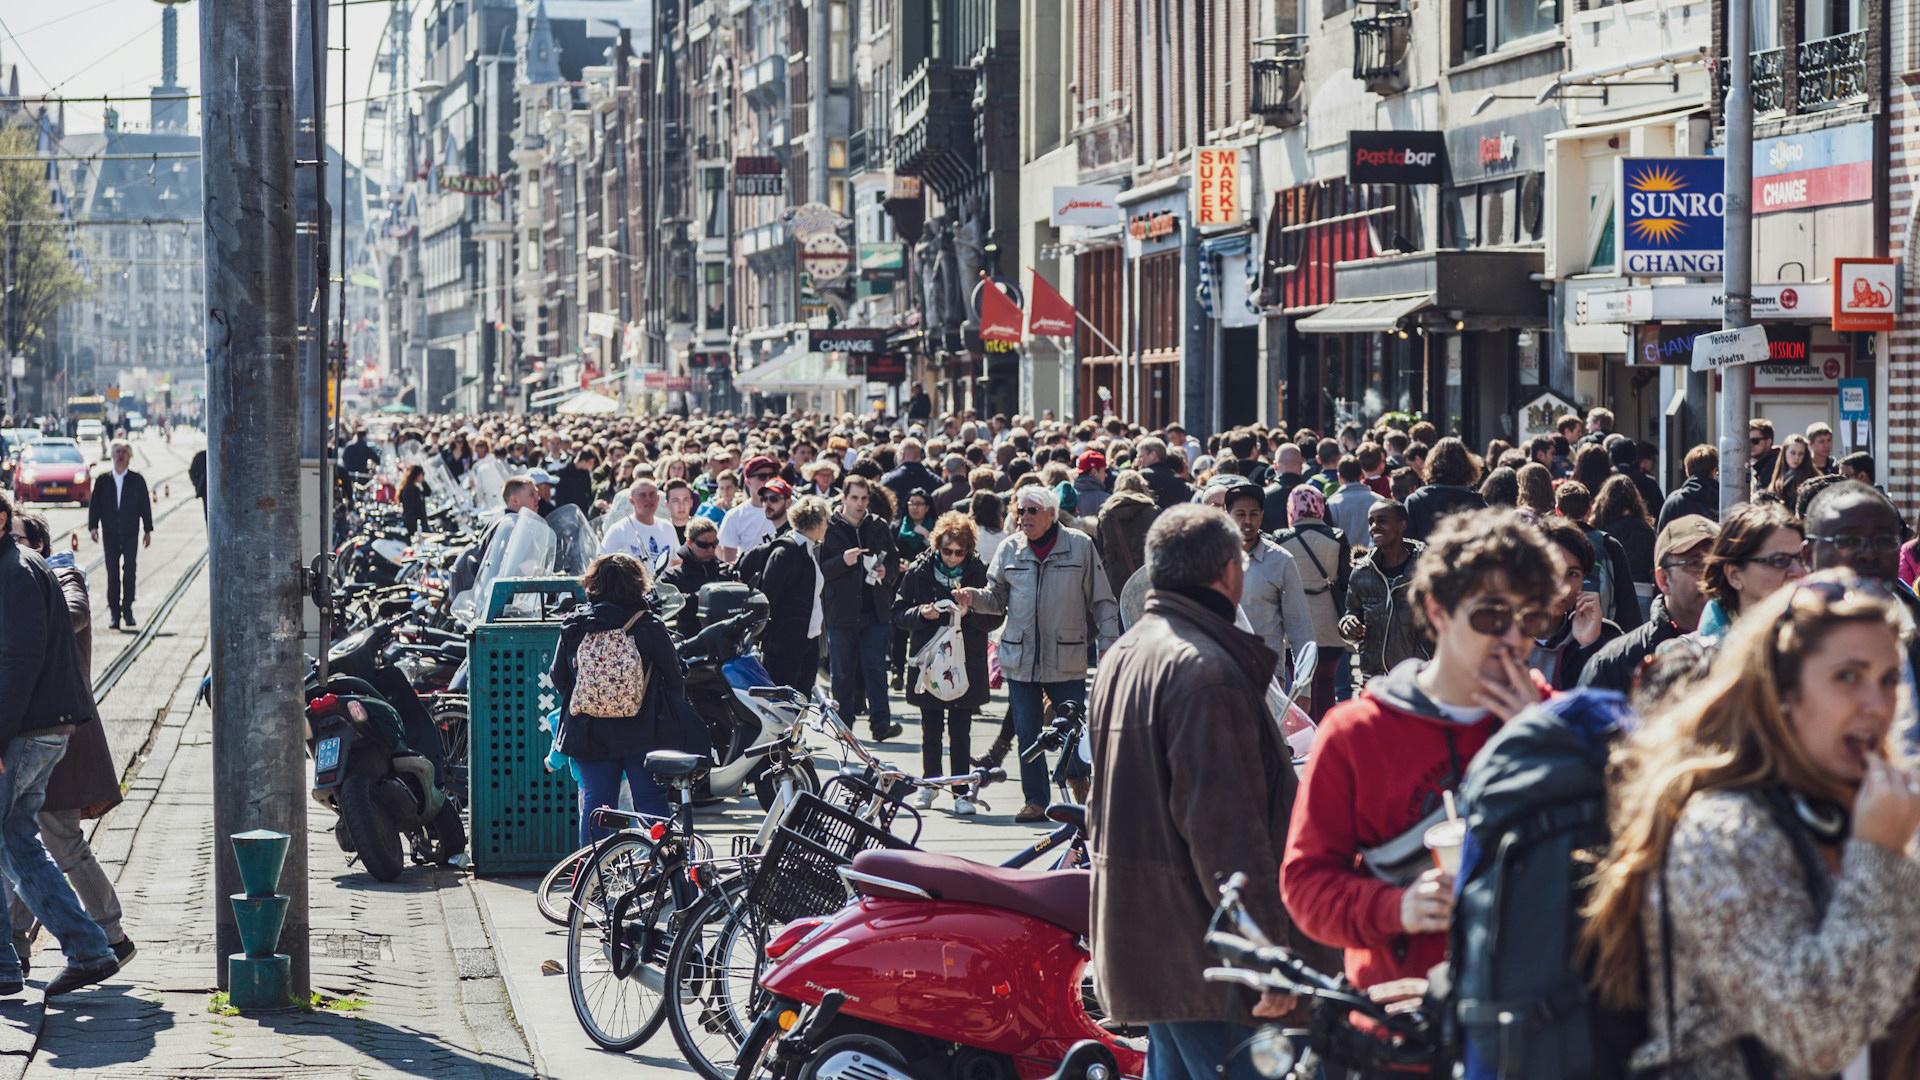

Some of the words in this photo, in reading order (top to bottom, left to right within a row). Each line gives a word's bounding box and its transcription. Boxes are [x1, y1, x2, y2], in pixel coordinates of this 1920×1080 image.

[1356, 148, 1436, 167] Pastabar
[1769, 144, 1803, 165] SUNRO
[737, 178, 780, 194] HOTEL
[1200, 151, 1213, 222] SUPER
[1219, 151, 1235, 222] MARKT
[1763, 178, 1807, 206] CHANGE
[819, 339, 874, 352] CHANGE
